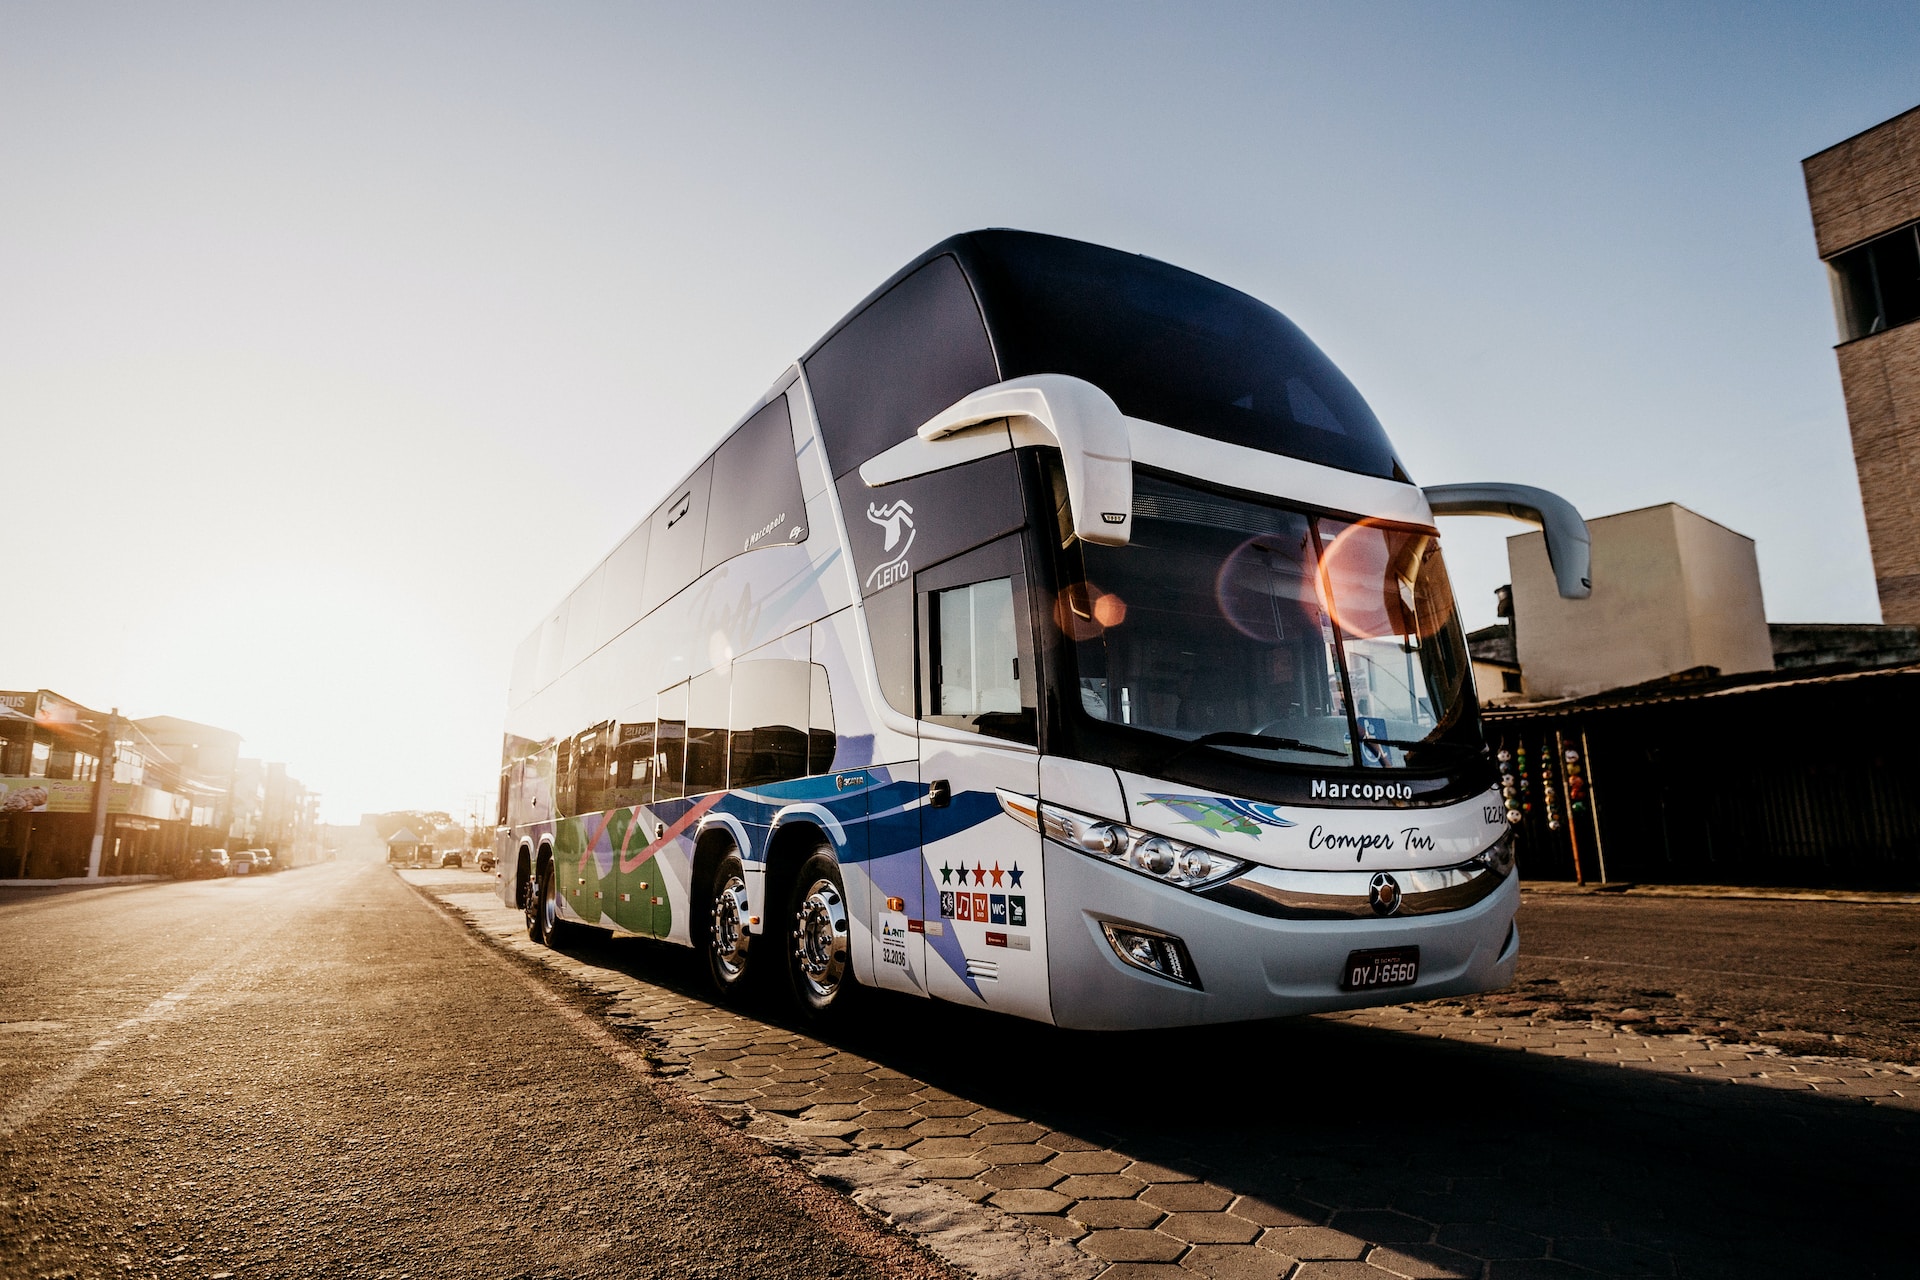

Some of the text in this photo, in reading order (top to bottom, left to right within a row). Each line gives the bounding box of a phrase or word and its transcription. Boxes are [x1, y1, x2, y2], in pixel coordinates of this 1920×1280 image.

[750, 513, 786, 546] Marcopolo
[877, 560, 909, 590] LEITO
[1311, 779, 1413, 800] Marcopolo
[1308, 824, 1436, 862] Comper Tur
[974, 898, 986, 911] TV
[991, 903, 1005, 916] WC
[882, 947, 906, 967] 32.2036
[1351, 962, 1416, 986] OYJ-6560
